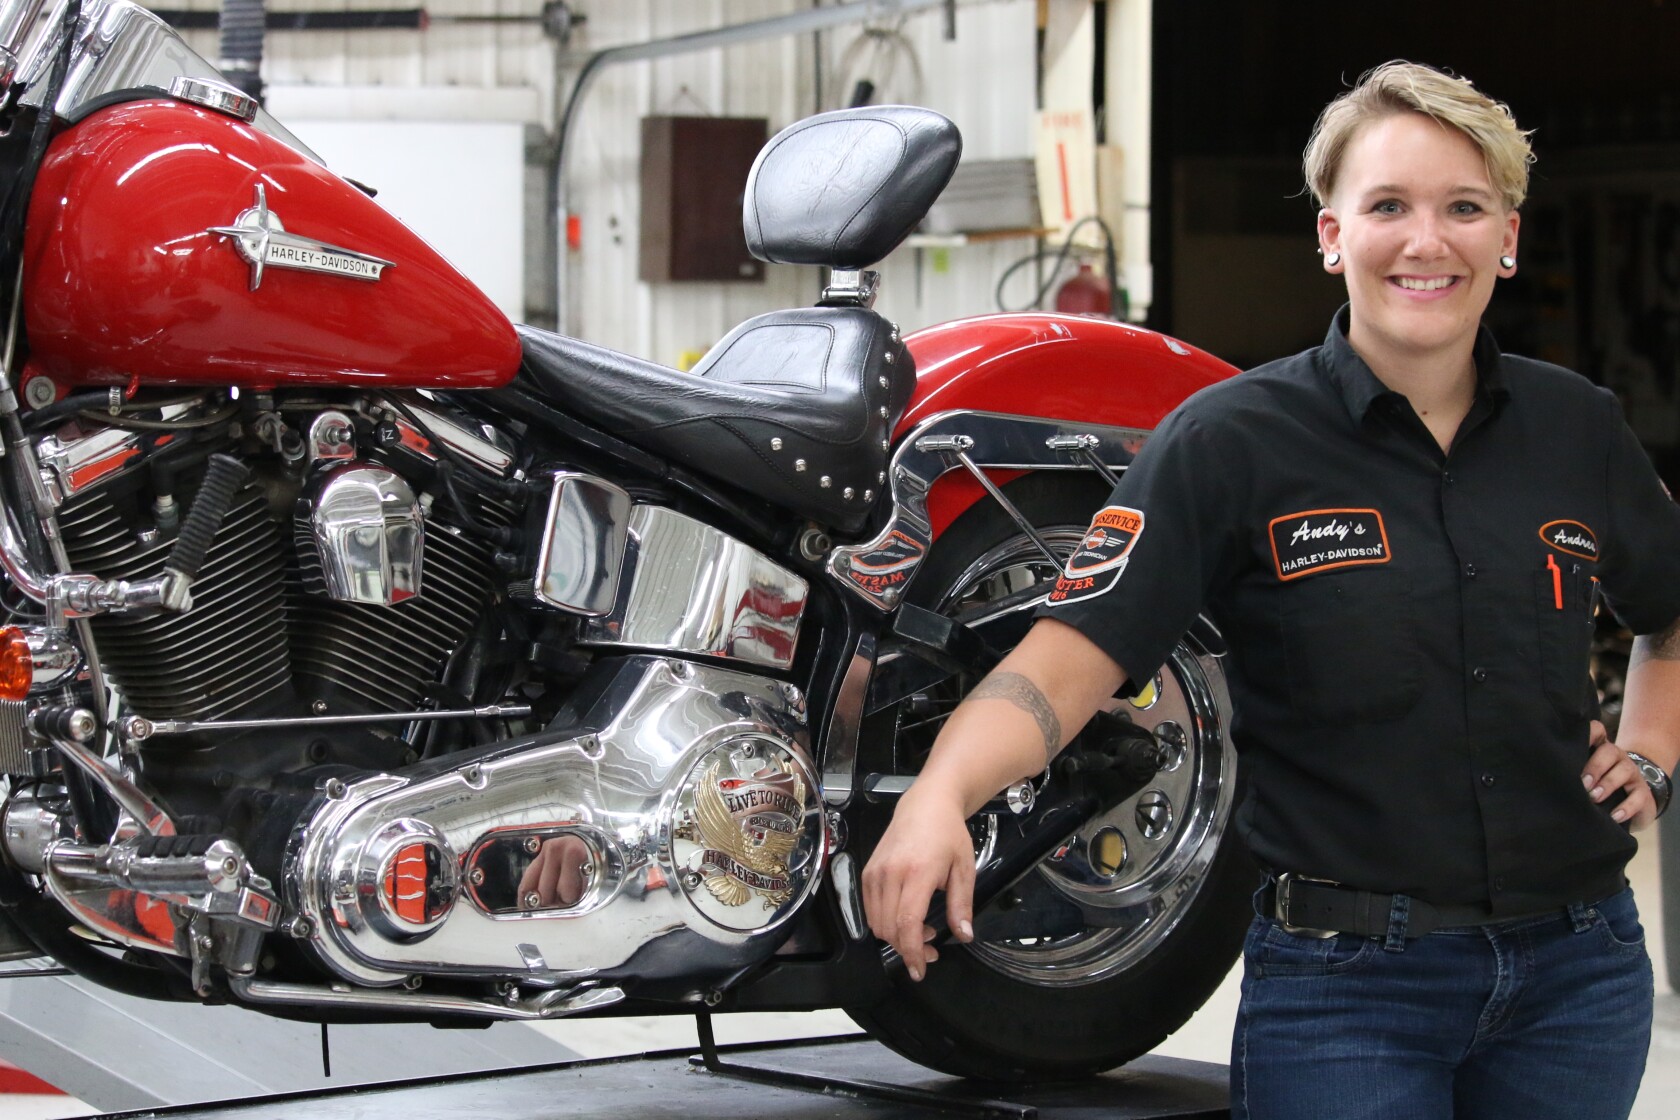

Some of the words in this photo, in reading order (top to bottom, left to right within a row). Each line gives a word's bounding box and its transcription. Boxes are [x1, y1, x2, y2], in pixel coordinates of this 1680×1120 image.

[271, 247, 368, 274] HARLEY-DAVIDSON
[1100, 513, 1141, 531] SERVICE
[1290, 519, 1366, 546] Andy's
[1282, 546, 1382, 571] HARLEY-DAVIDSON
[729, 790, 759, 813] LIVE
[759, 791, 773, 805] TO
